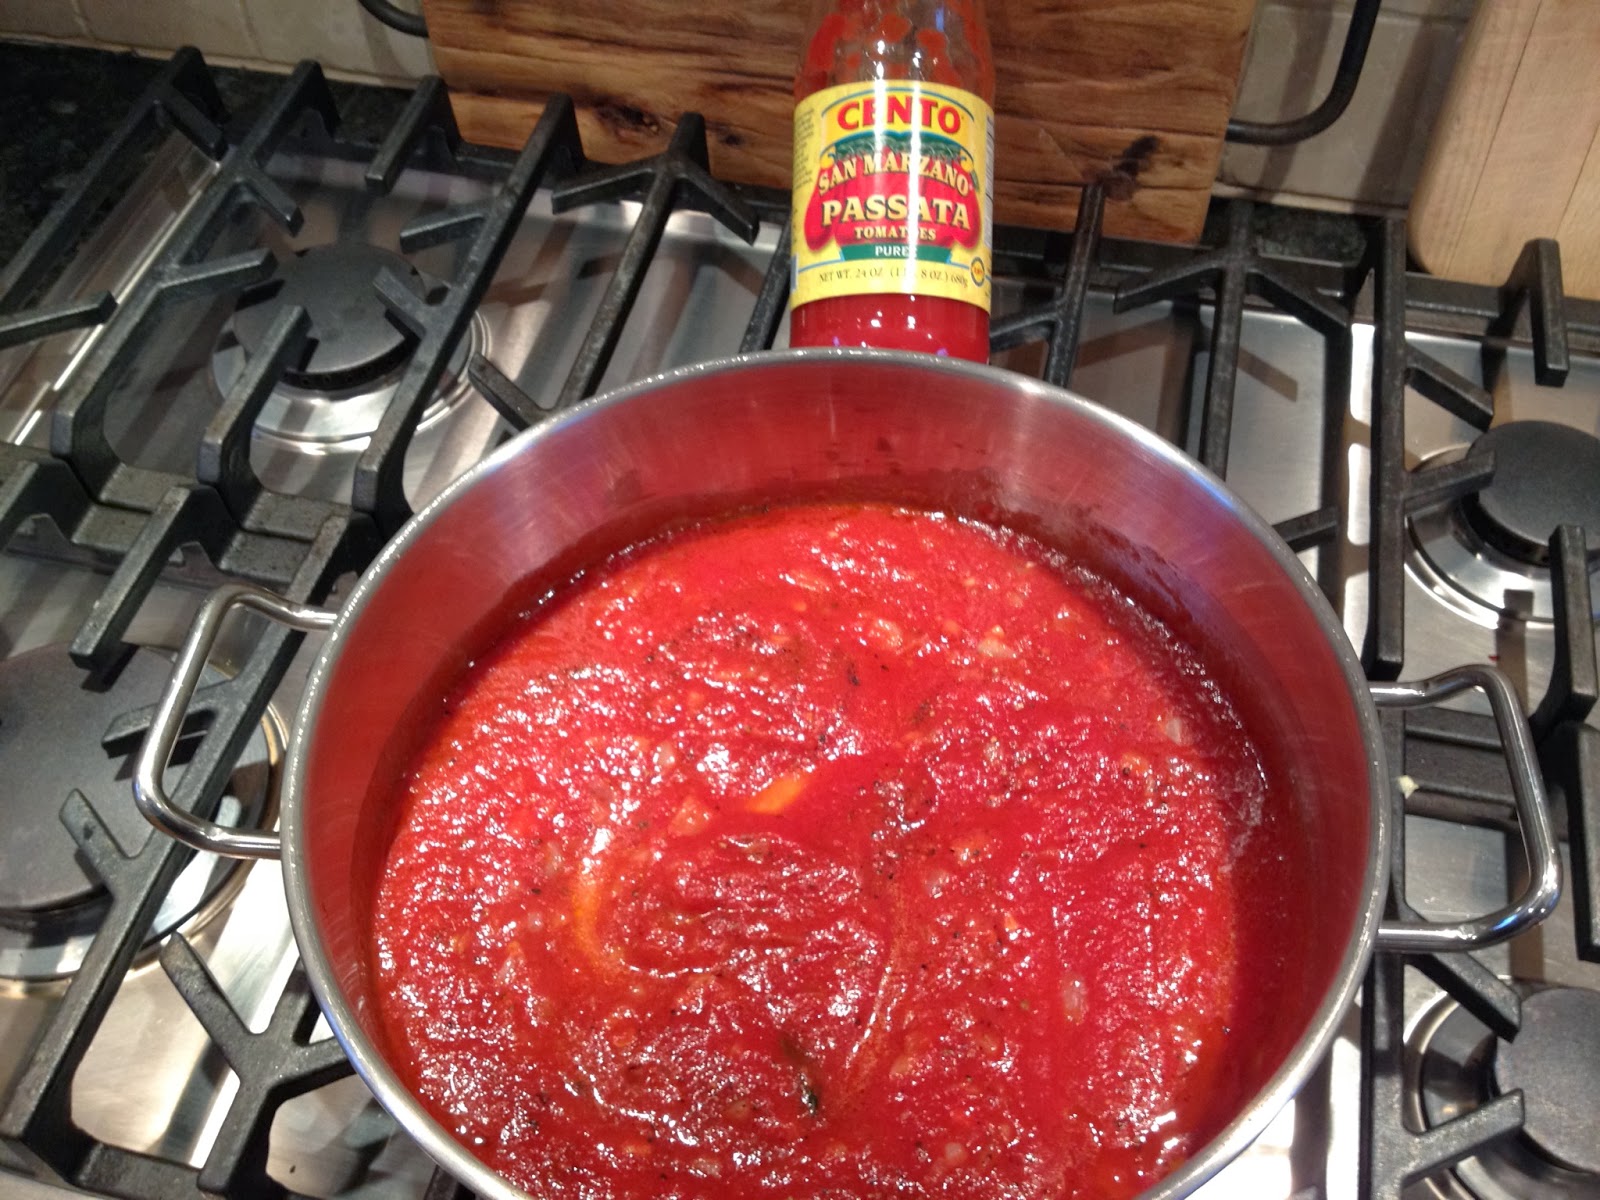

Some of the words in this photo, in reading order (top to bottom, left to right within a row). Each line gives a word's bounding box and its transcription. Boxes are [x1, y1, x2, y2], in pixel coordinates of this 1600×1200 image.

[818, 157, 857, 196] SAN
[863, 151, 969, 197] MARZANO
[822, 194, 970, 230] PASSATA
[854, 225, 937, 241] TOMATES
[818, 271, 834, 283] NET
[921, 269, 928, 279] 8
